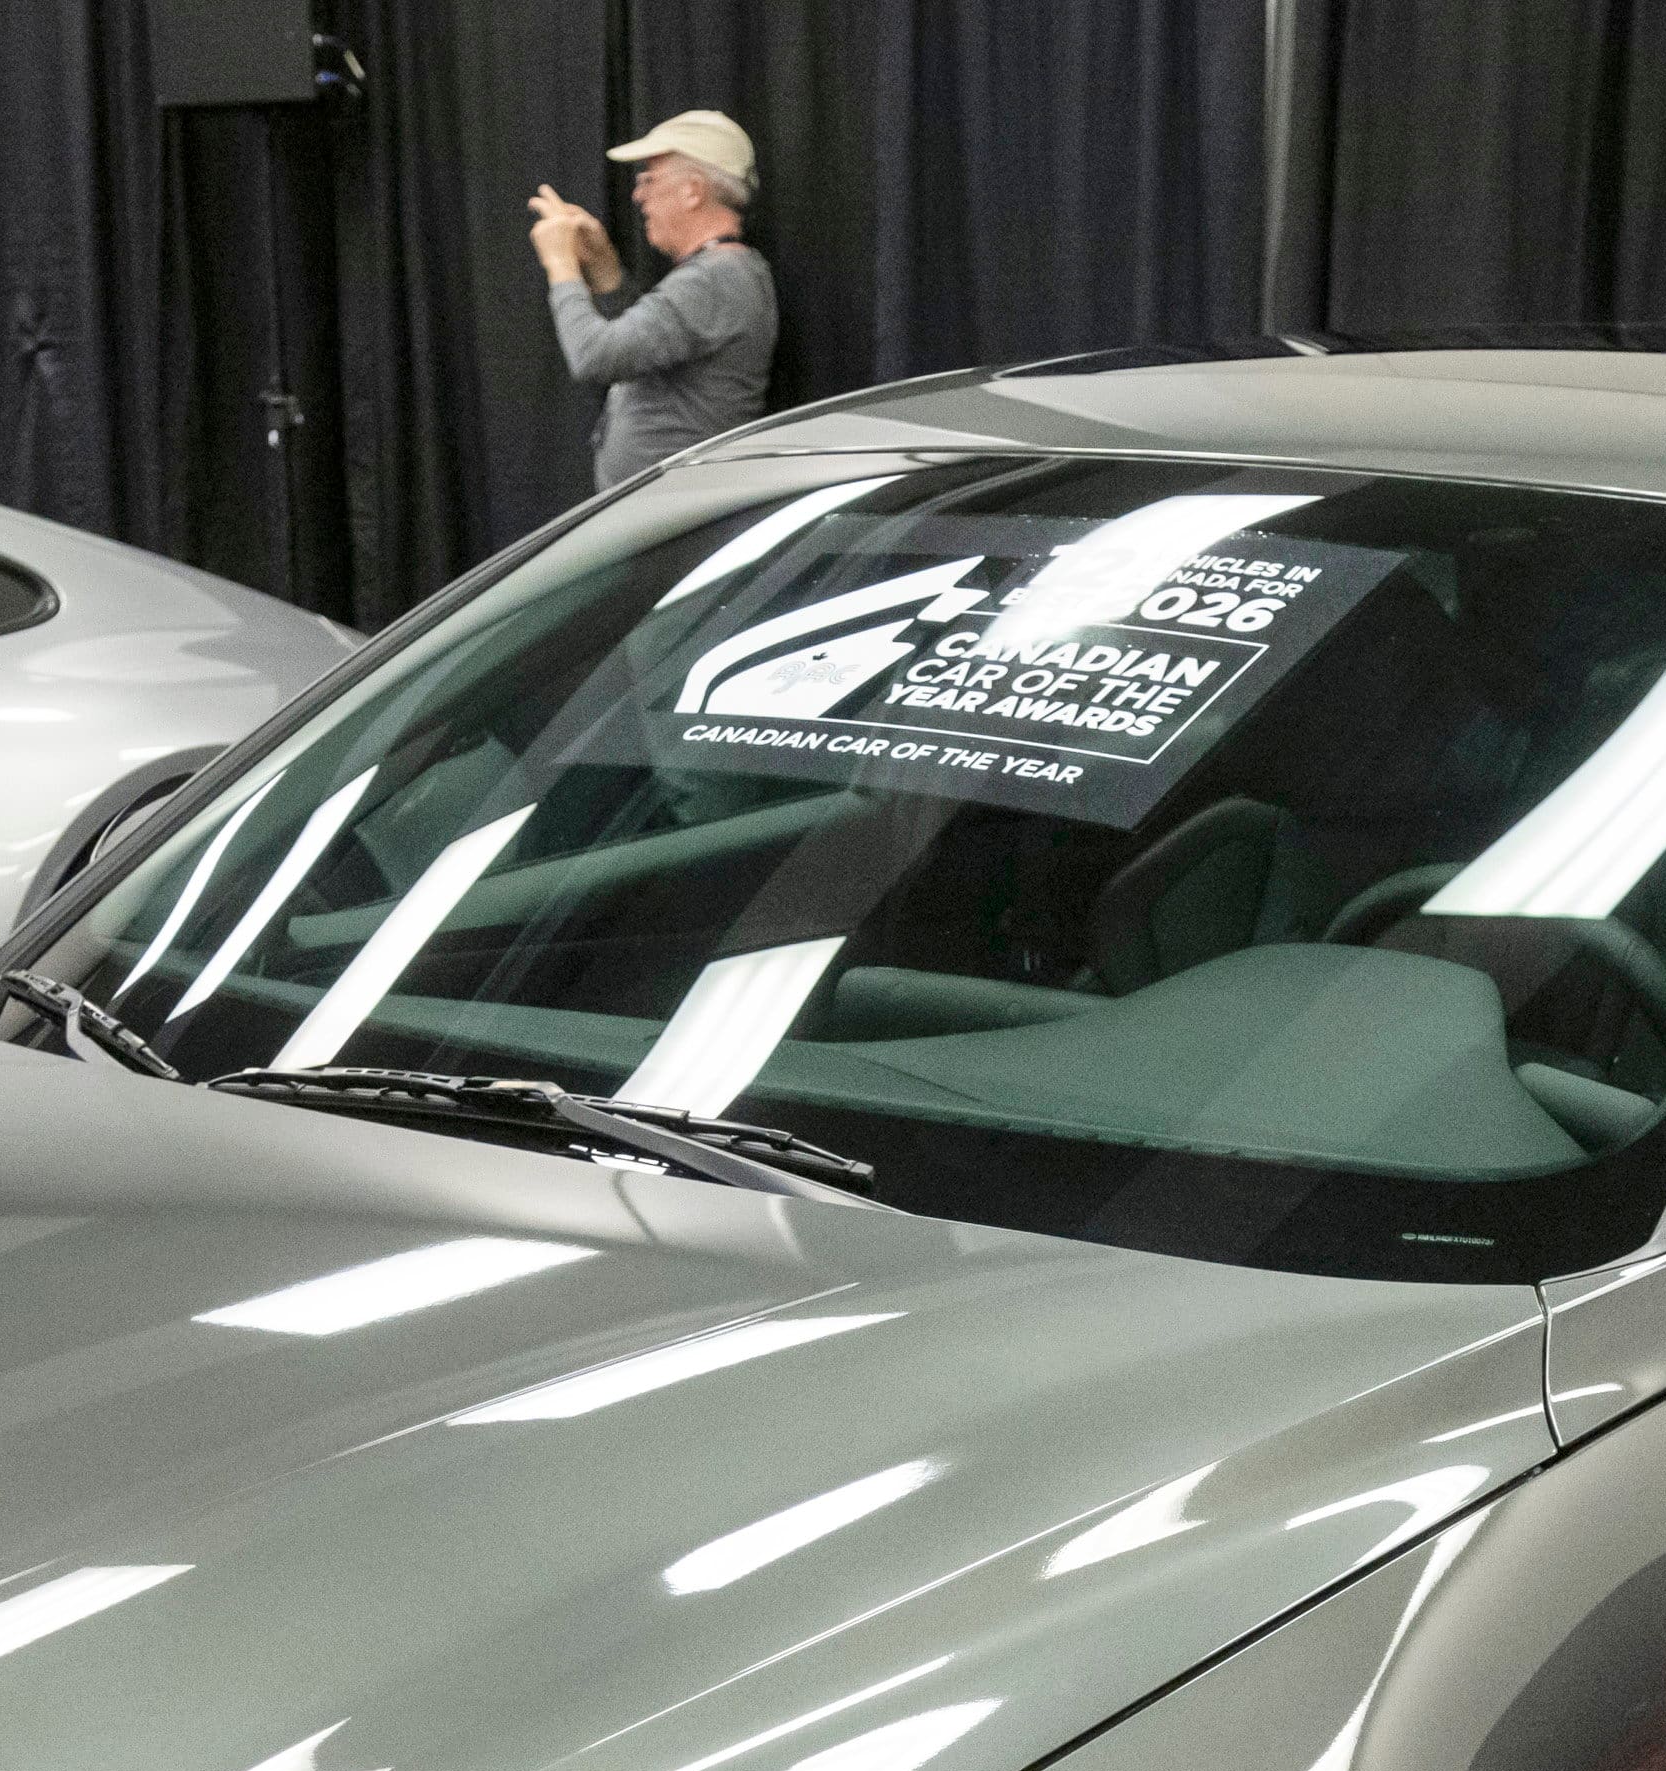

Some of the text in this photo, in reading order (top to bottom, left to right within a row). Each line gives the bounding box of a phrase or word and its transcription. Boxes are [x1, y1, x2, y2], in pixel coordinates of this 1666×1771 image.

[1166, 570, 1304, 598] NADA FOR
[1183, 555, 1322, 583] HICLES IN
[1138, 586, 1287, 632] 026
[934, 632, 1220, 687] CANADIAN
[884, 683, 1163, 737] YEAR AWARDS
[906, 659, 1193, 715] CAR OF THE
[682, 724, 1084, 784] CANADIAN CAR OF THE YEAR
